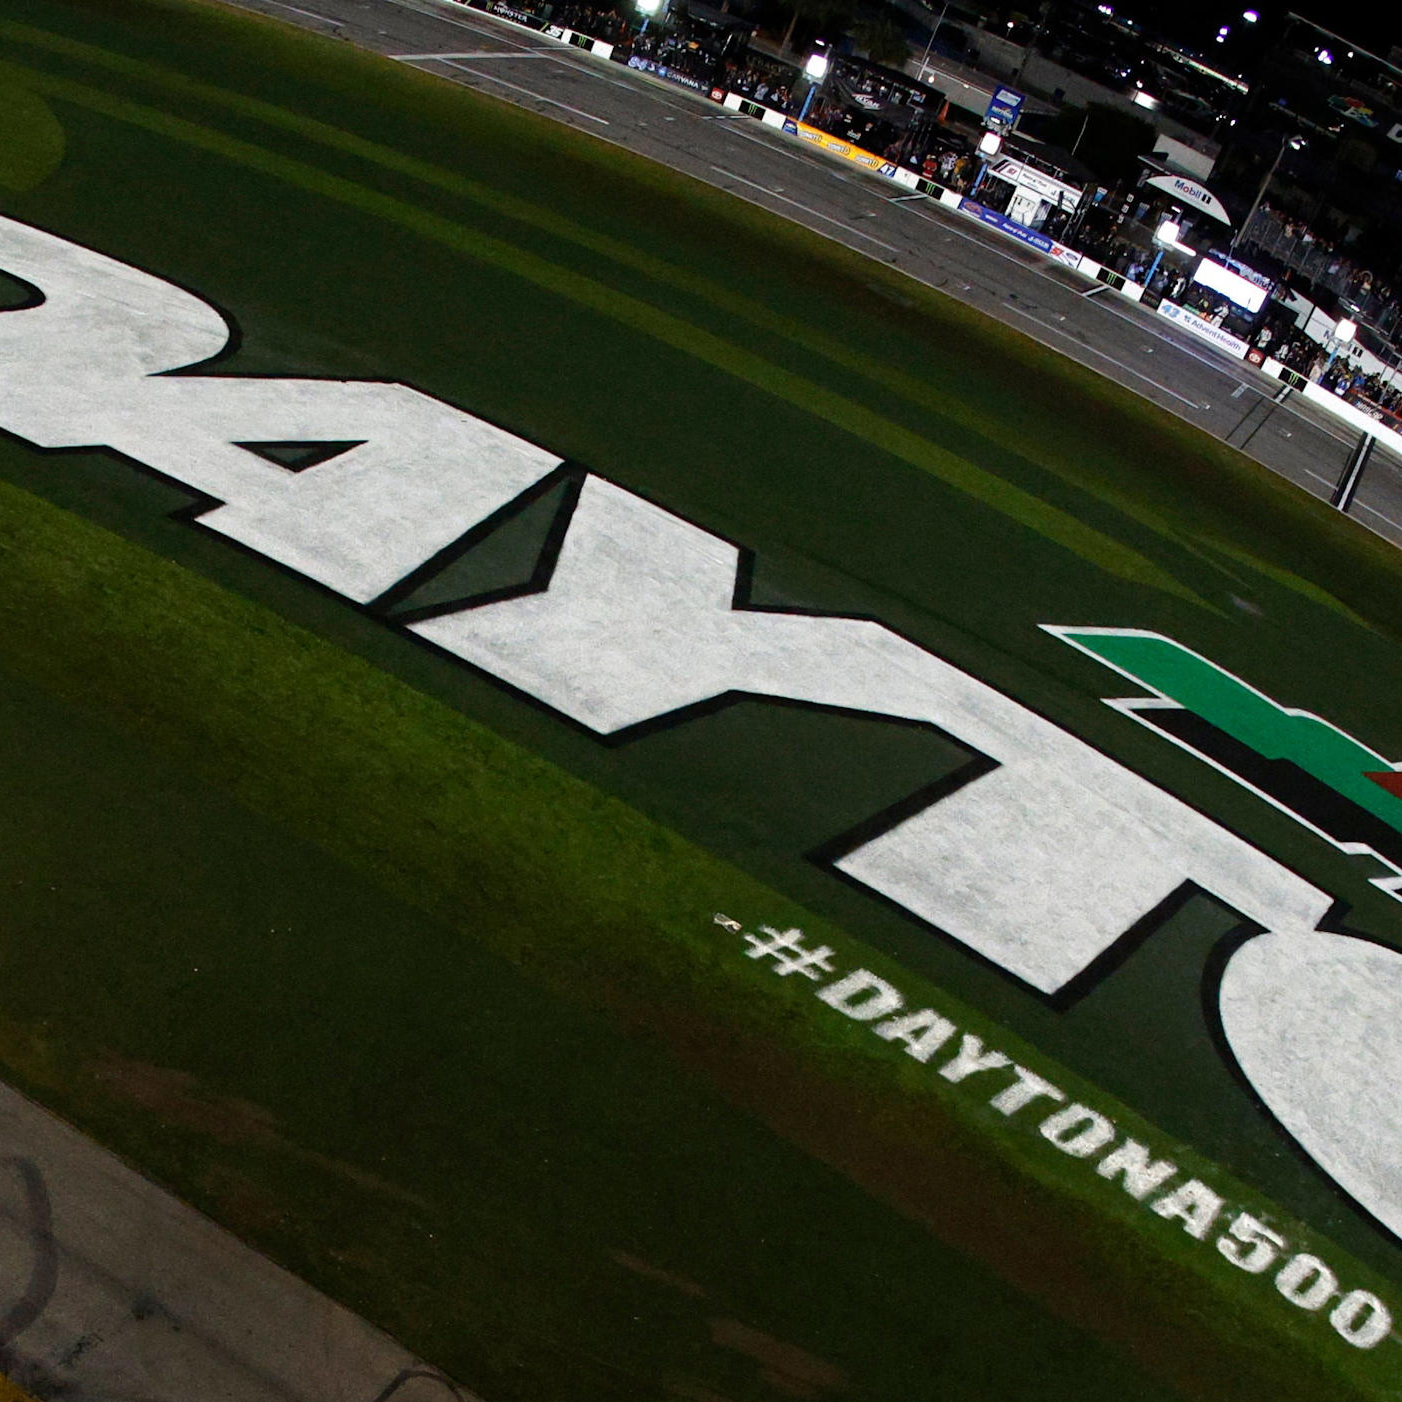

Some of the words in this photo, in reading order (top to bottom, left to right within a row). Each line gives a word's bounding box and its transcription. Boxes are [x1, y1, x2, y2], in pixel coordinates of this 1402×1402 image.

[1173, 179, 1202, 199] Mobil
[1161, 303, 1179, 318] 43
[740, 924, 1394, 1350] #DAYTONA500
